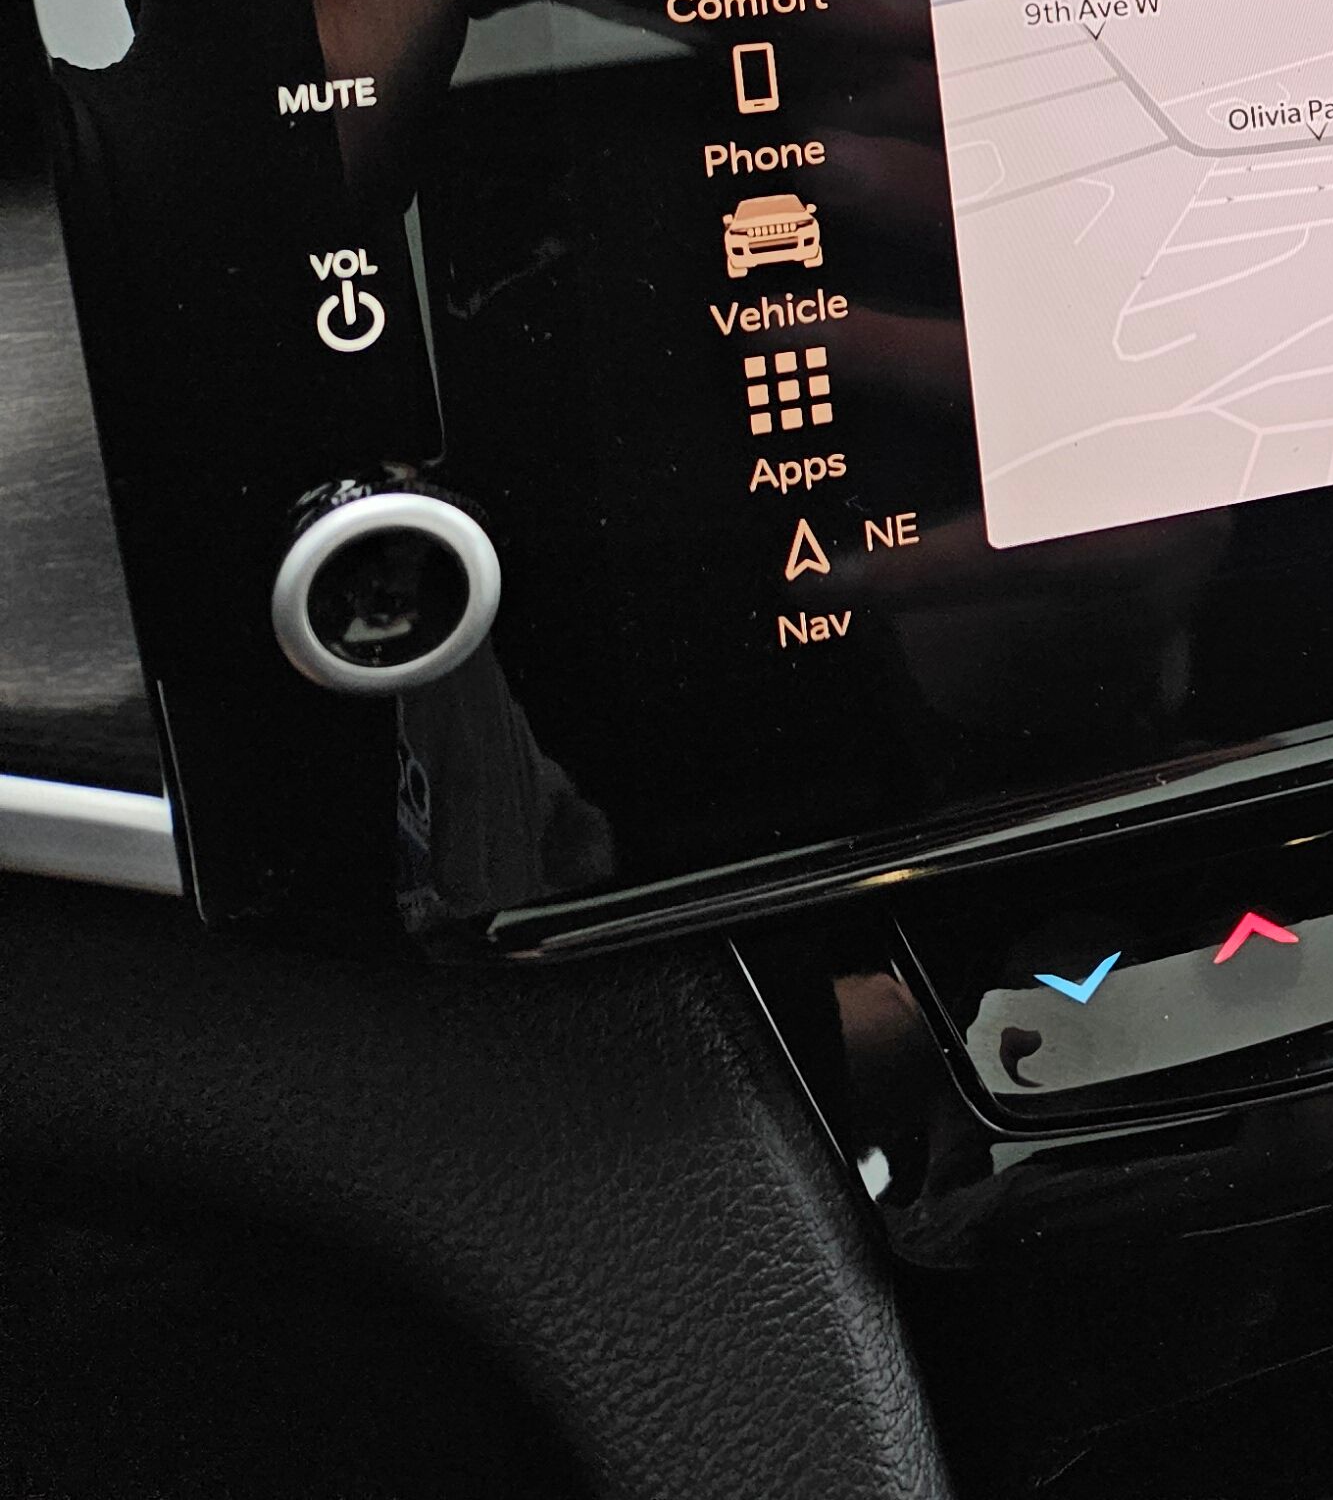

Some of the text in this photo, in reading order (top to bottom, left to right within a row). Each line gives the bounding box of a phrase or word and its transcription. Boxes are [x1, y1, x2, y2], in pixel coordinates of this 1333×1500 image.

[1024, 2, 1071, 27] 9th
[278, 77, 378, 116] MUTE
[1228, 102, 1302, 131] Olivia
[704, 142, 826, 176] Phone
[309, 248, 378, 281] VOL
[711, 289, 848, 336] Vehicle
[750, 453, 846, 495] Apps
[864, 512, 919, 551] NE
[777, 609, 853, 649] Nav
